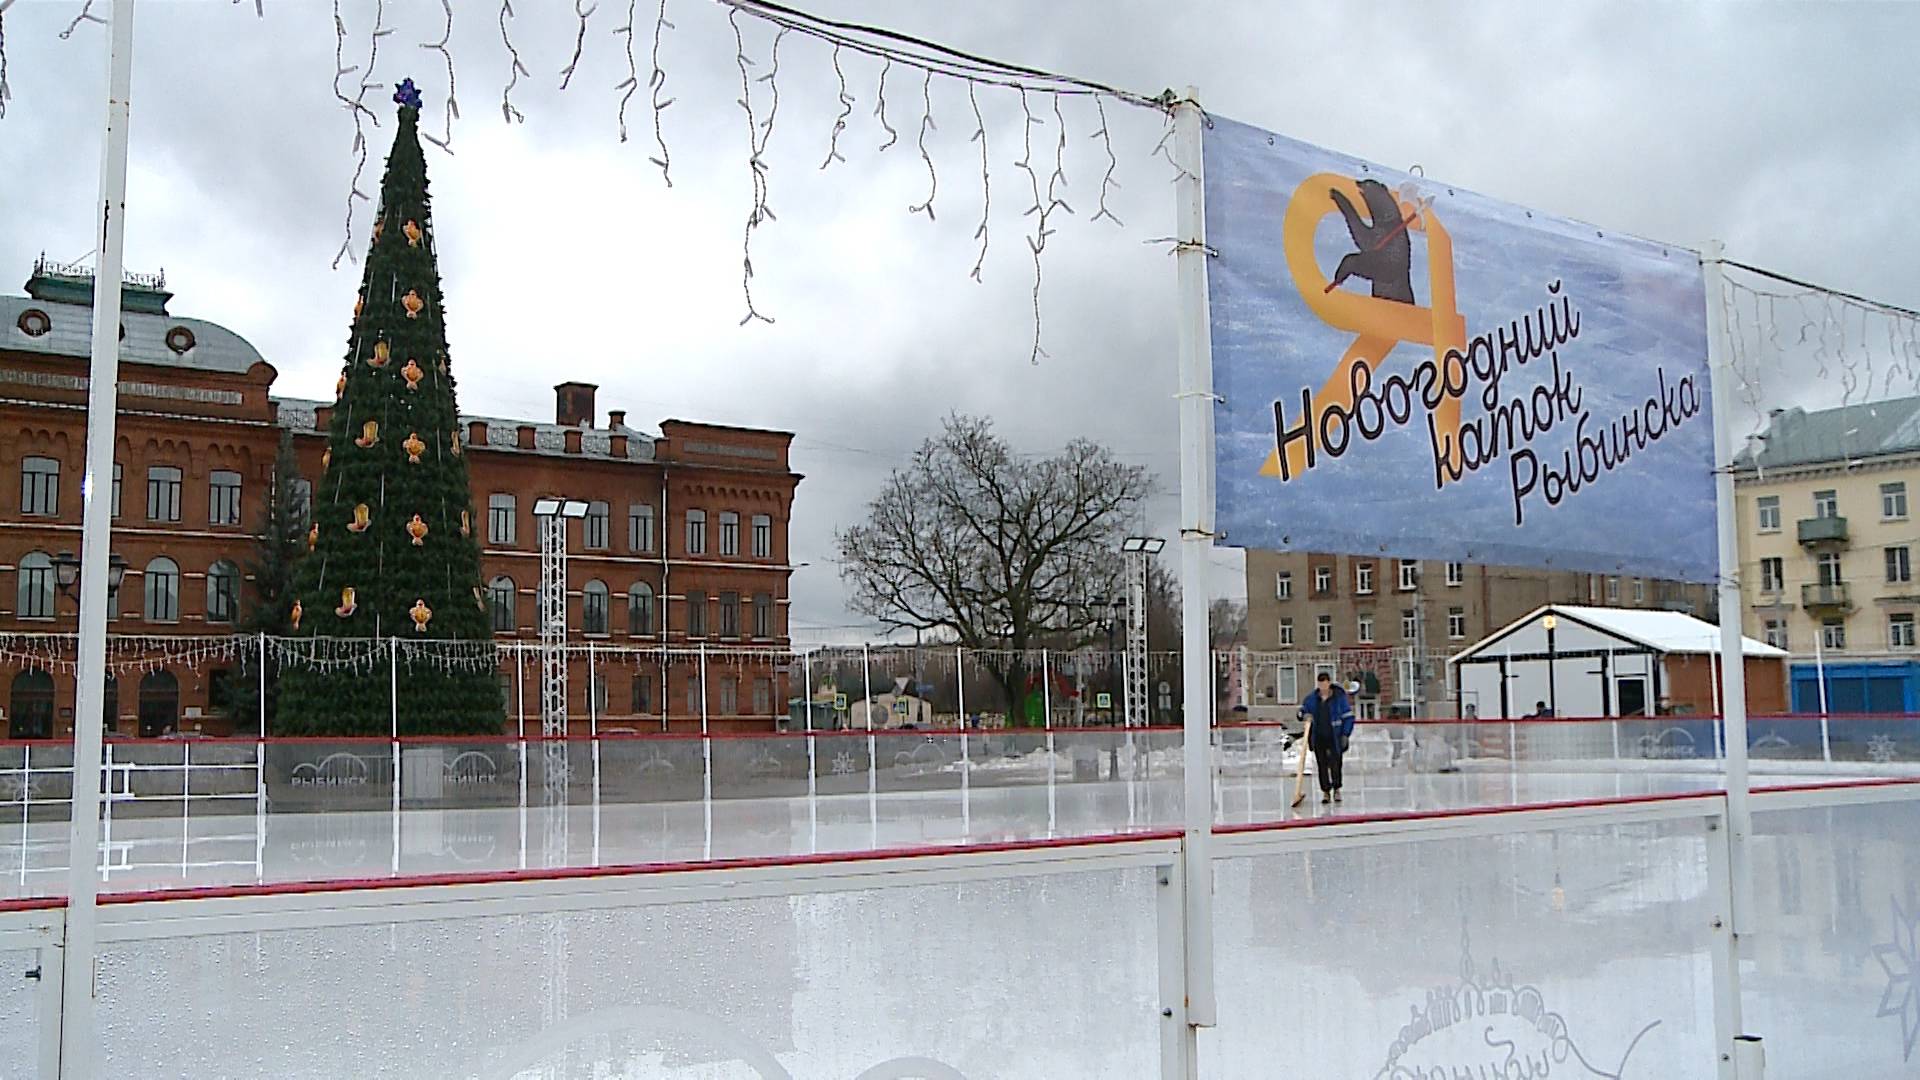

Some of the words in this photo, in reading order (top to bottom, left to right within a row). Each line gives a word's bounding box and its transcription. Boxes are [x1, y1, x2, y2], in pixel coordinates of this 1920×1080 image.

[1273, 279, 1581, 482] Новогодний
[1427, 351, 1583, 489] каток
[1509, 366, 1702, 526] Рыбинска
